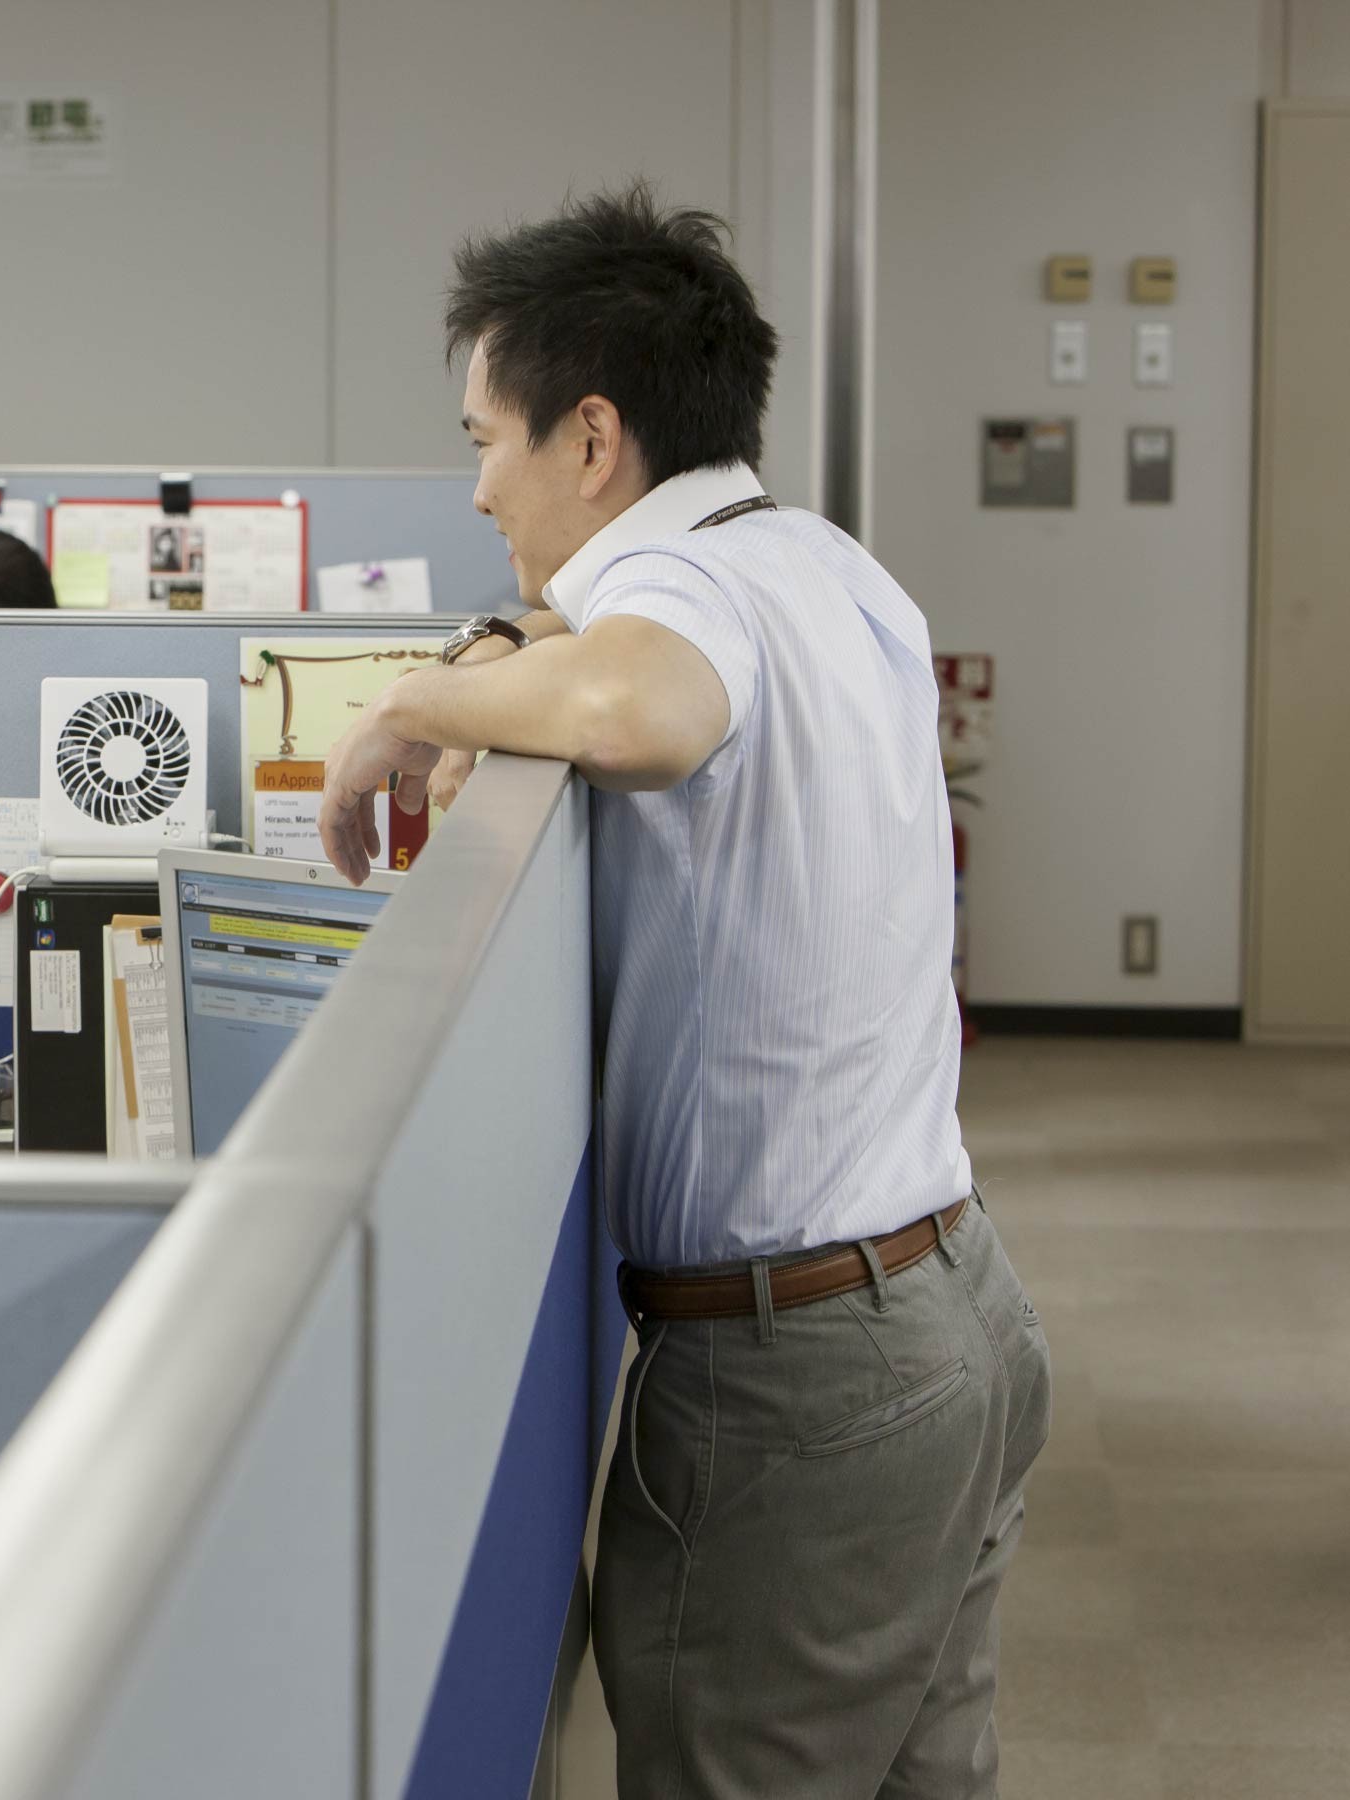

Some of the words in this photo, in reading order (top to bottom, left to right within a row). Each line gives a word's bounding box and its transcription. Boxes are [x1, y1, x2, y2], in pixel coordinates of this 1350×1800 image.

[263, 773, 276, 787] In
[295, 816, 316, 824] Mami
[395, 848, 409, 870] 5
